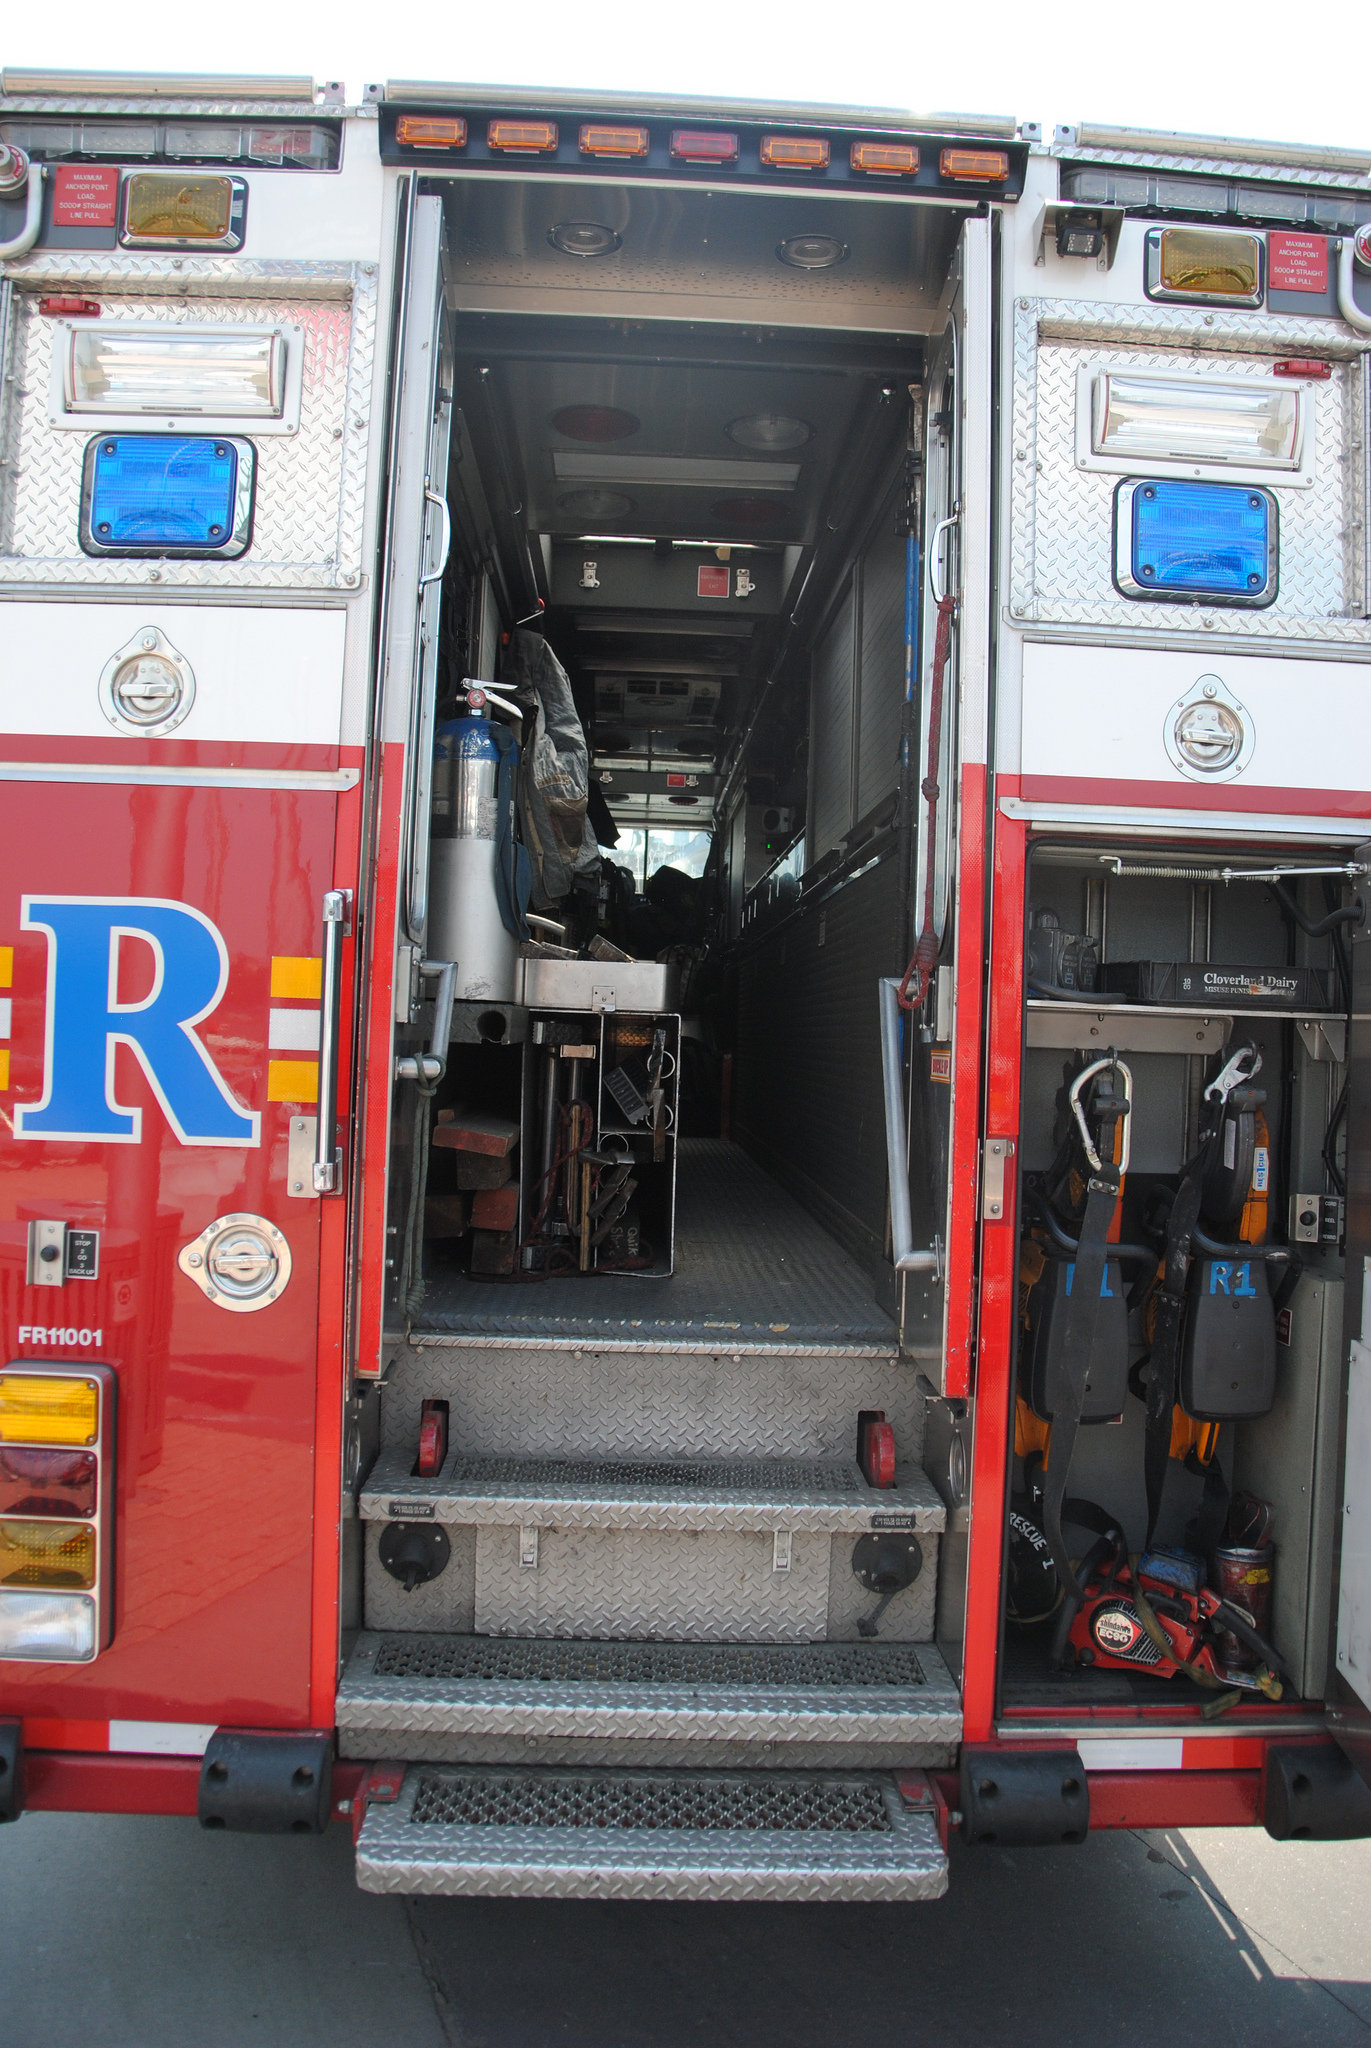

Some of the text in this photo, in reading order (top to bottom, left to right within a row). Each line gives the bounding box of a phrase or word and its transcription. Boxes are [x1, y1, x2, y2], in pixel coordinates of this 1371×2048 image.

[83, 202, 112, 210] STRAIGHT
[1285, 240, 1313, 249] MAXIMUM
[1279, 249, 1319, 258] ANCHOR POINT
[1296, 268, 1323, 277] STRAIGHT
[1203, 972, 1298, 990] Cloverland Dairy
[1204, 985, 1229, 994] MISUSE
[13, 894, 261, 1147] R
[1210, 1261, 1257, 1296] R1
[18, 1326, 102, 1346] FR11001
[1009, 1512, 1054, 1570] RESCUE 1
[1100, 1629, 1129, 1643] EC90
